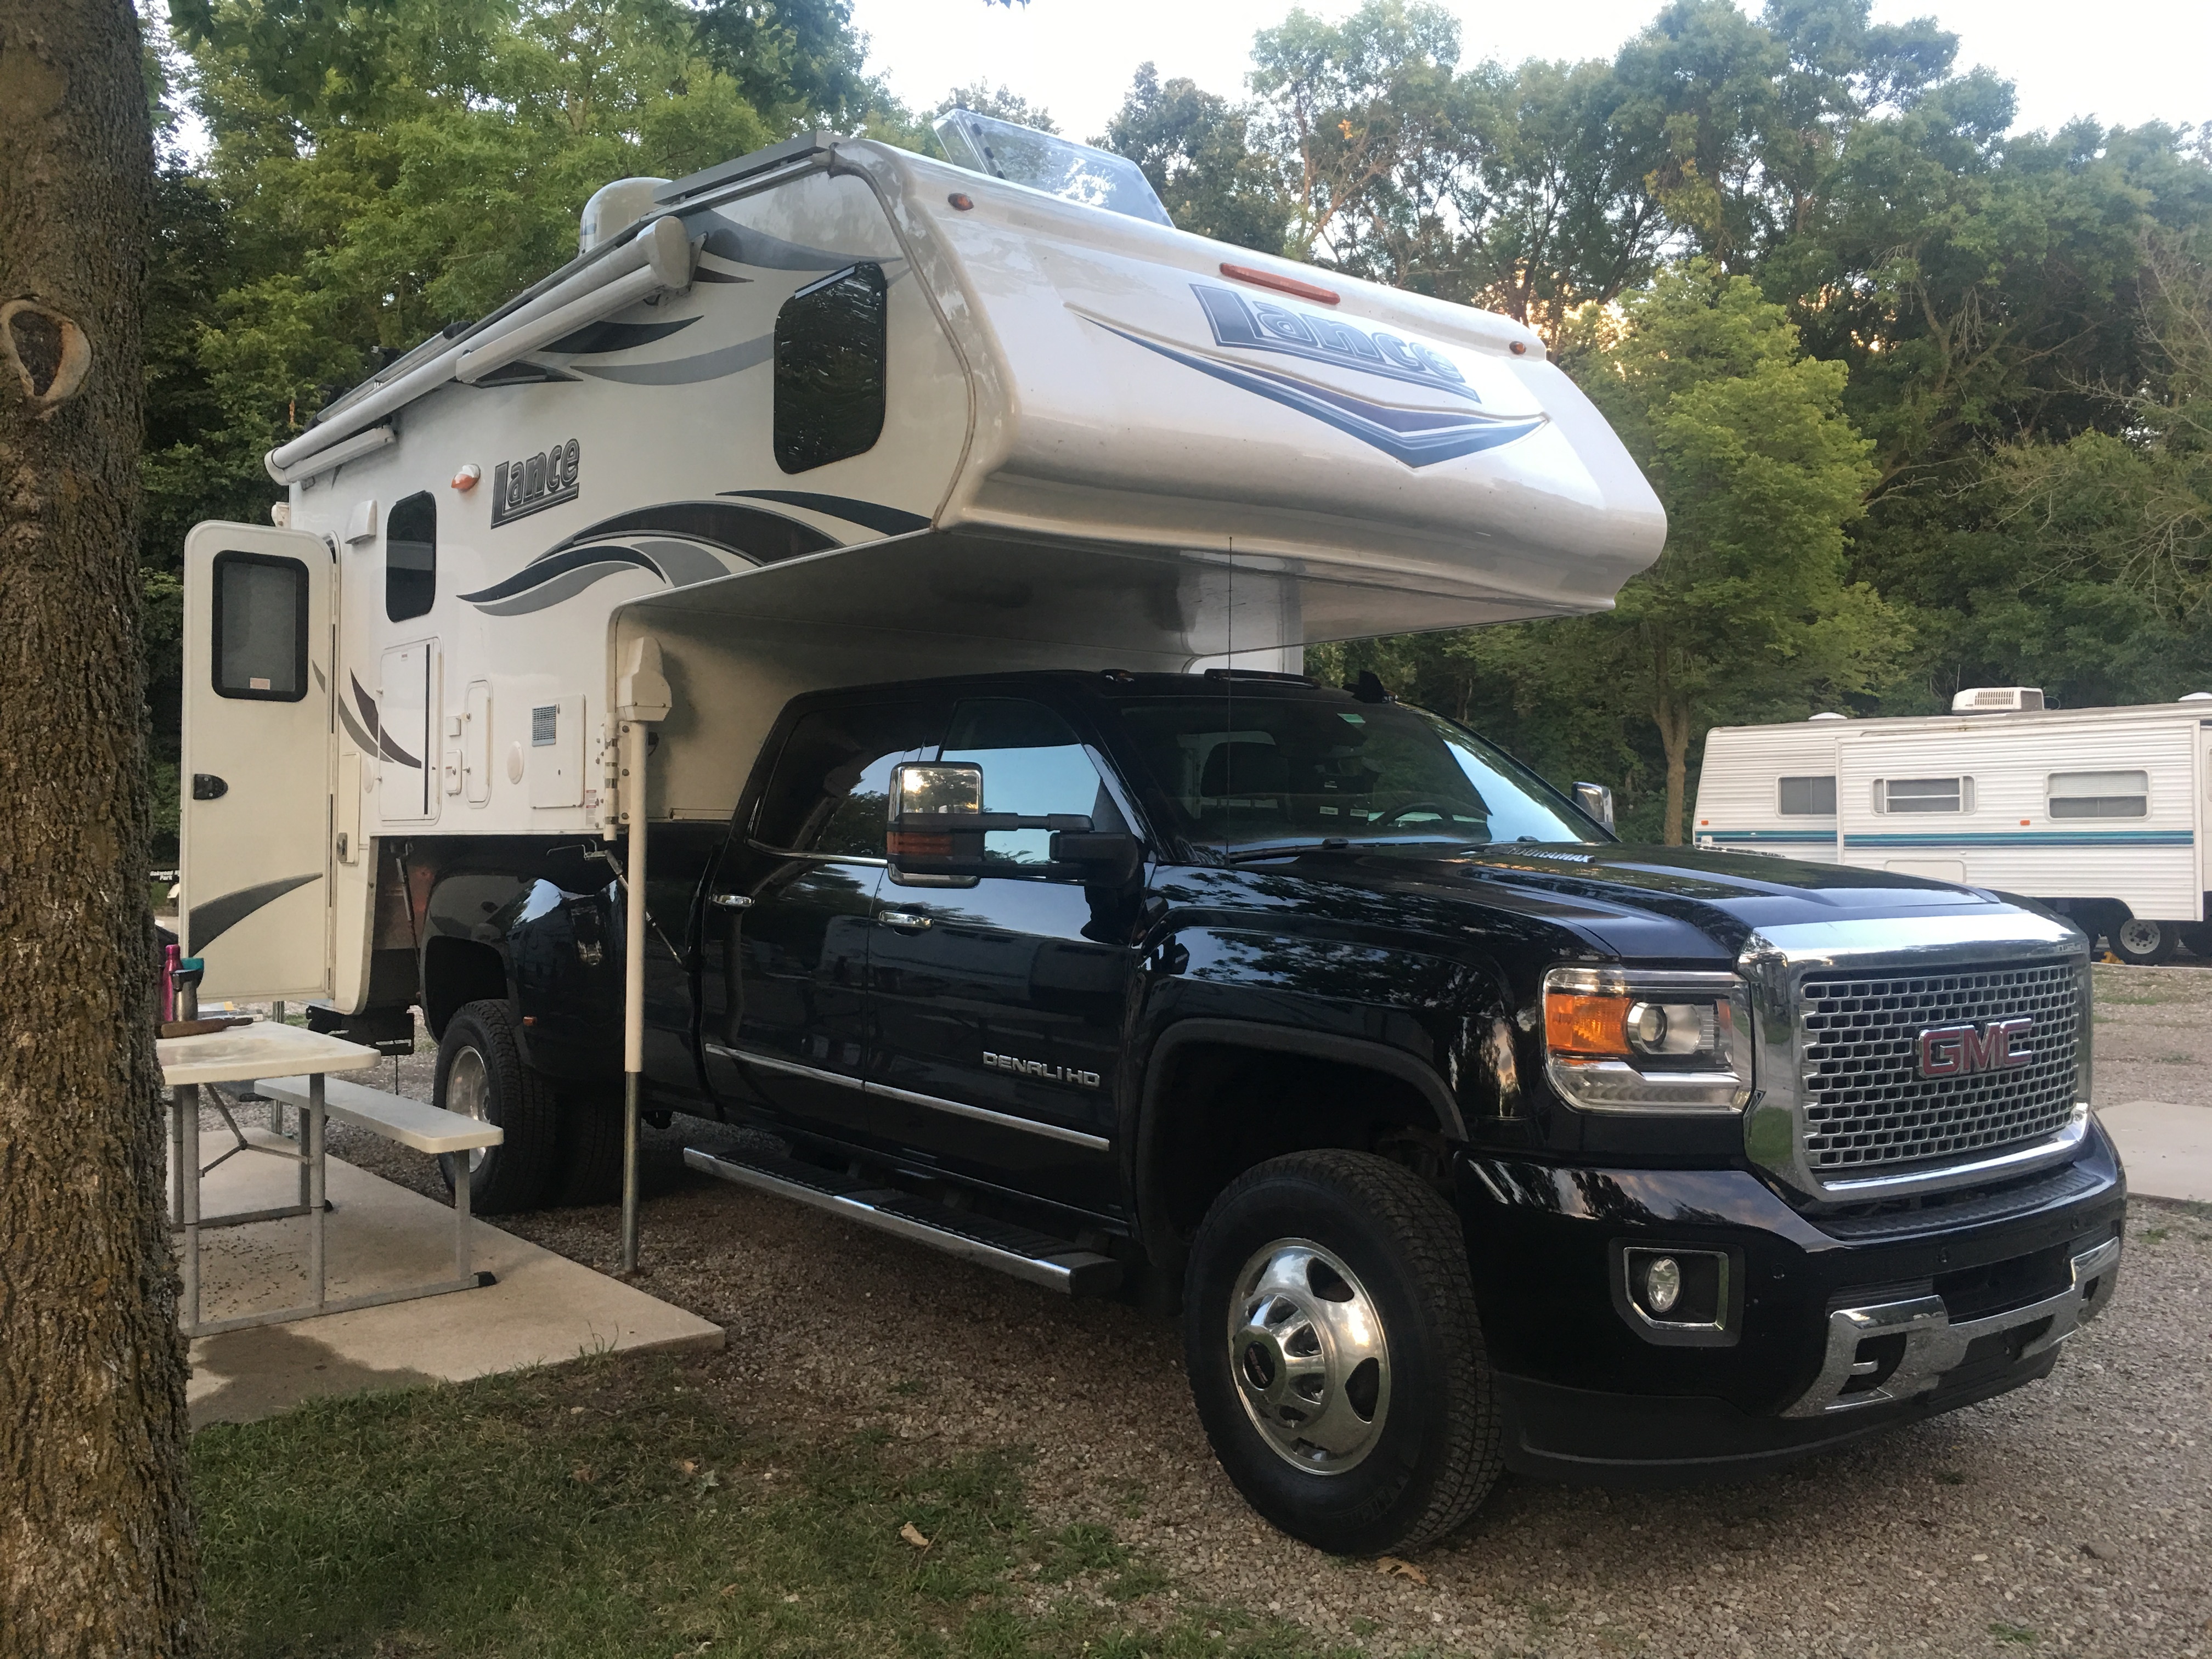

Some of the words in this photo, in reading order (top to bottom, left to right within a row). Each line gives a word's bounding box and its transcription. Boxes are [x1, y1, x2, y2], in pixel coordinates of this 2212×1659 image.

[1188, 283, 1482, 404] Lance
[490, 438, 580, 529] Lance
[983, 1051, 1062, 1080] DENALI
[1066, 1068, 1100, 1087] HD
[1918, 1018, 2032, 1079] GMC
